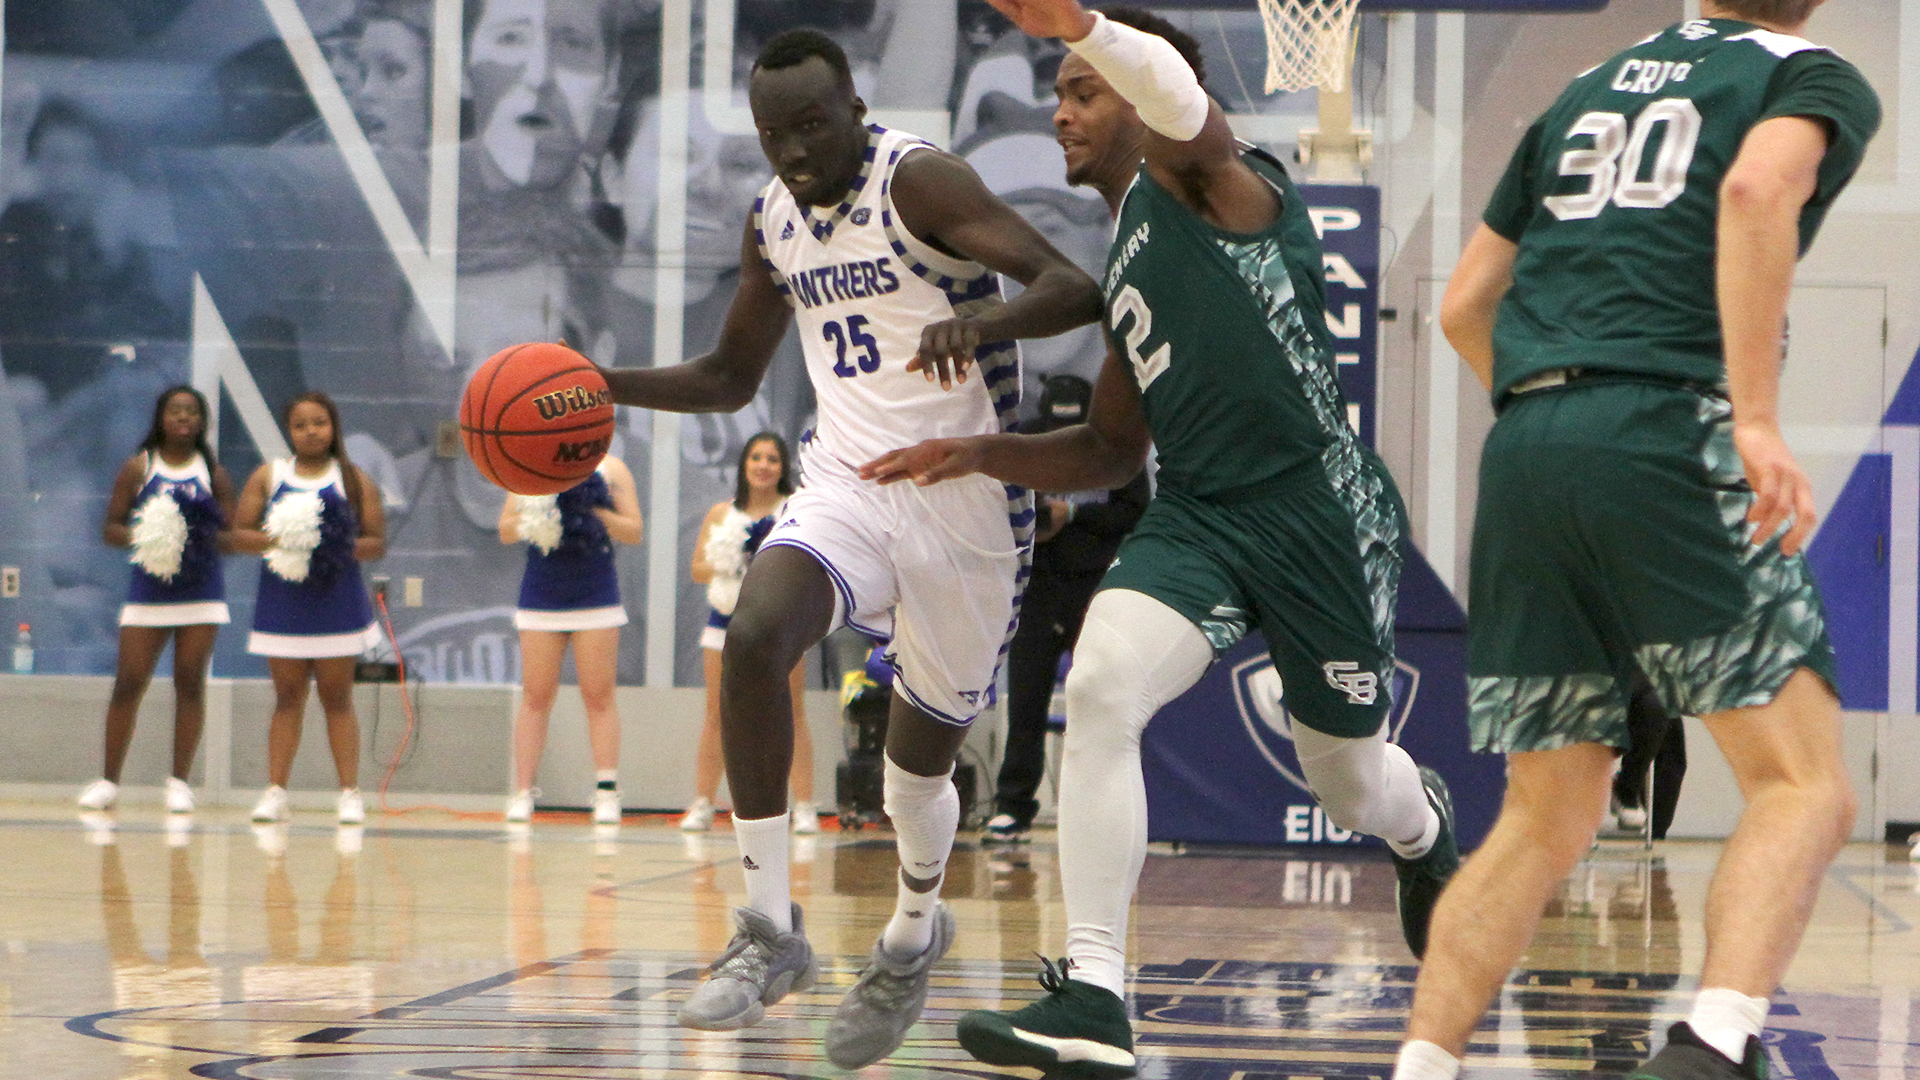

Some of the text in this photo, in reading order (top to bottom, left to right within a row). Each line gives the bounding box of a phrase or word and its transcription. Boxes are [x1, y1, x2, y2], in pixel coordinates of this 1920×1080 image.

[1542, 98, 1702, 221] 30
[823, 314, 881, 378] 25
[1112, 284, 1171, 394] 2
